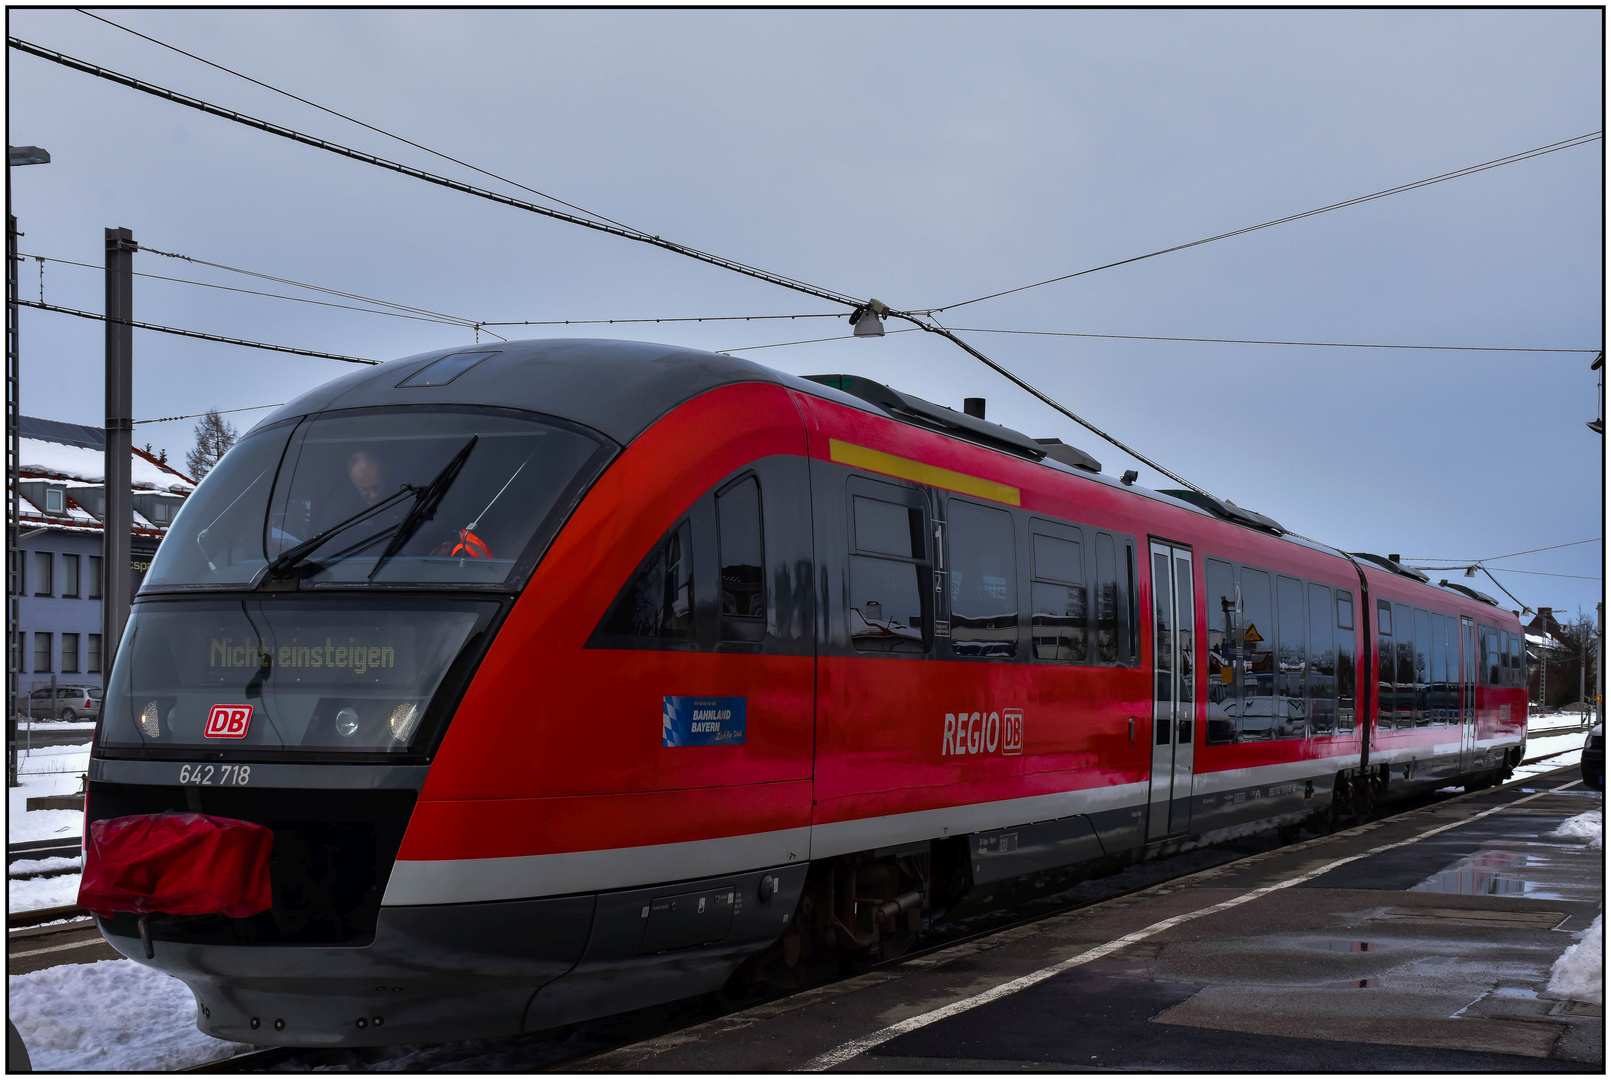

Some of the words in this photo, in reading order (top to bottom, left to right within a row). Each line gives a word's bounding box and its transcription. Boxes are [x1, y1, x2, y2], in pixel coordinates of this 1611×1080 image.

[934, 525, 944, 569] 1
[210, 637, 269, 667] Nicht
[278, 637, 395, 675] einsteigen
[209, 708, 247, 735] DB
[691, 722, 720, 732] BAYERN
[692, 710, 731, 720] BAHNLAND
[941, 711, 1000, 756] REGIO
[1004, 713, 1022, 750] DB
[179, 764, 214, 786] 642
[219, 764, 251, 786] 718
